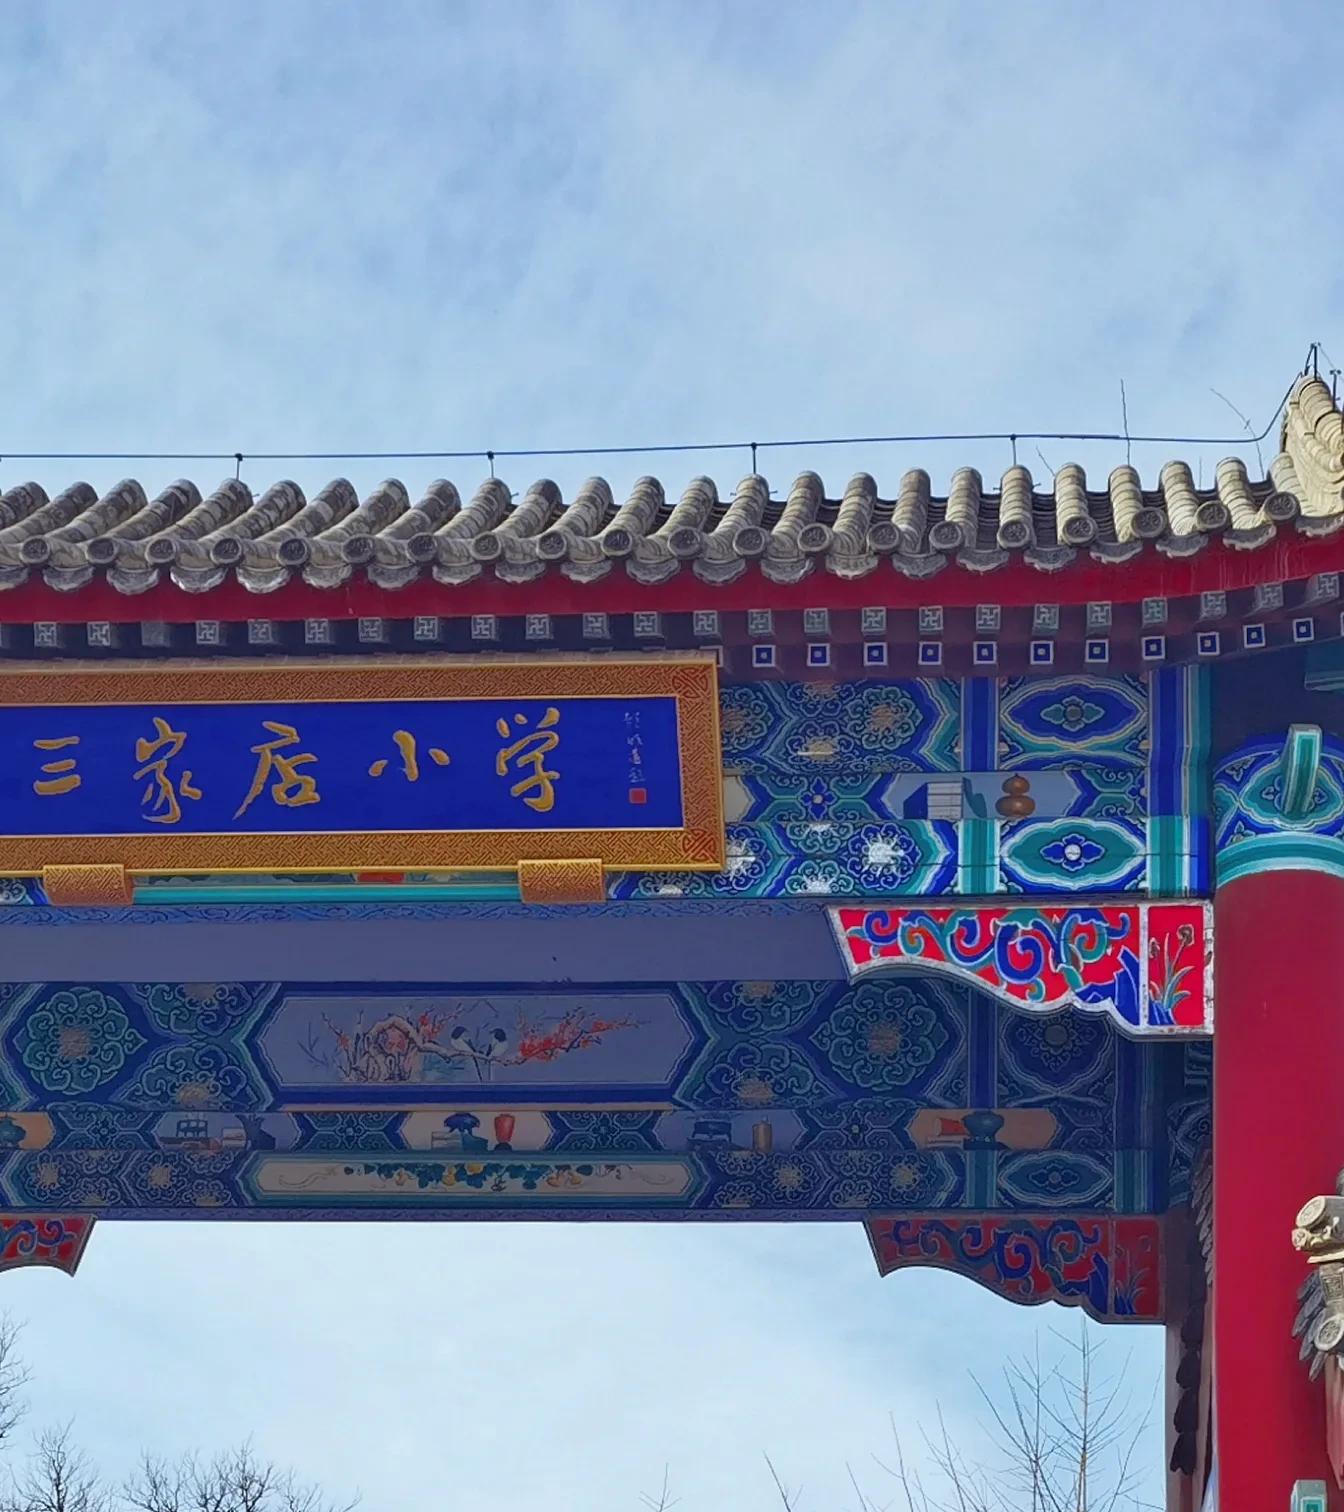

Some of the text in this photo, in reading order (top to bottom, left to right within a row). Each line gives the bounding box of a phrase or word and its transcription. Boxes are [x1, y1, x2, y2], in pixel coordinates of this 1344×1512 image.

[32, 706, 561, 823] 三家店小学
